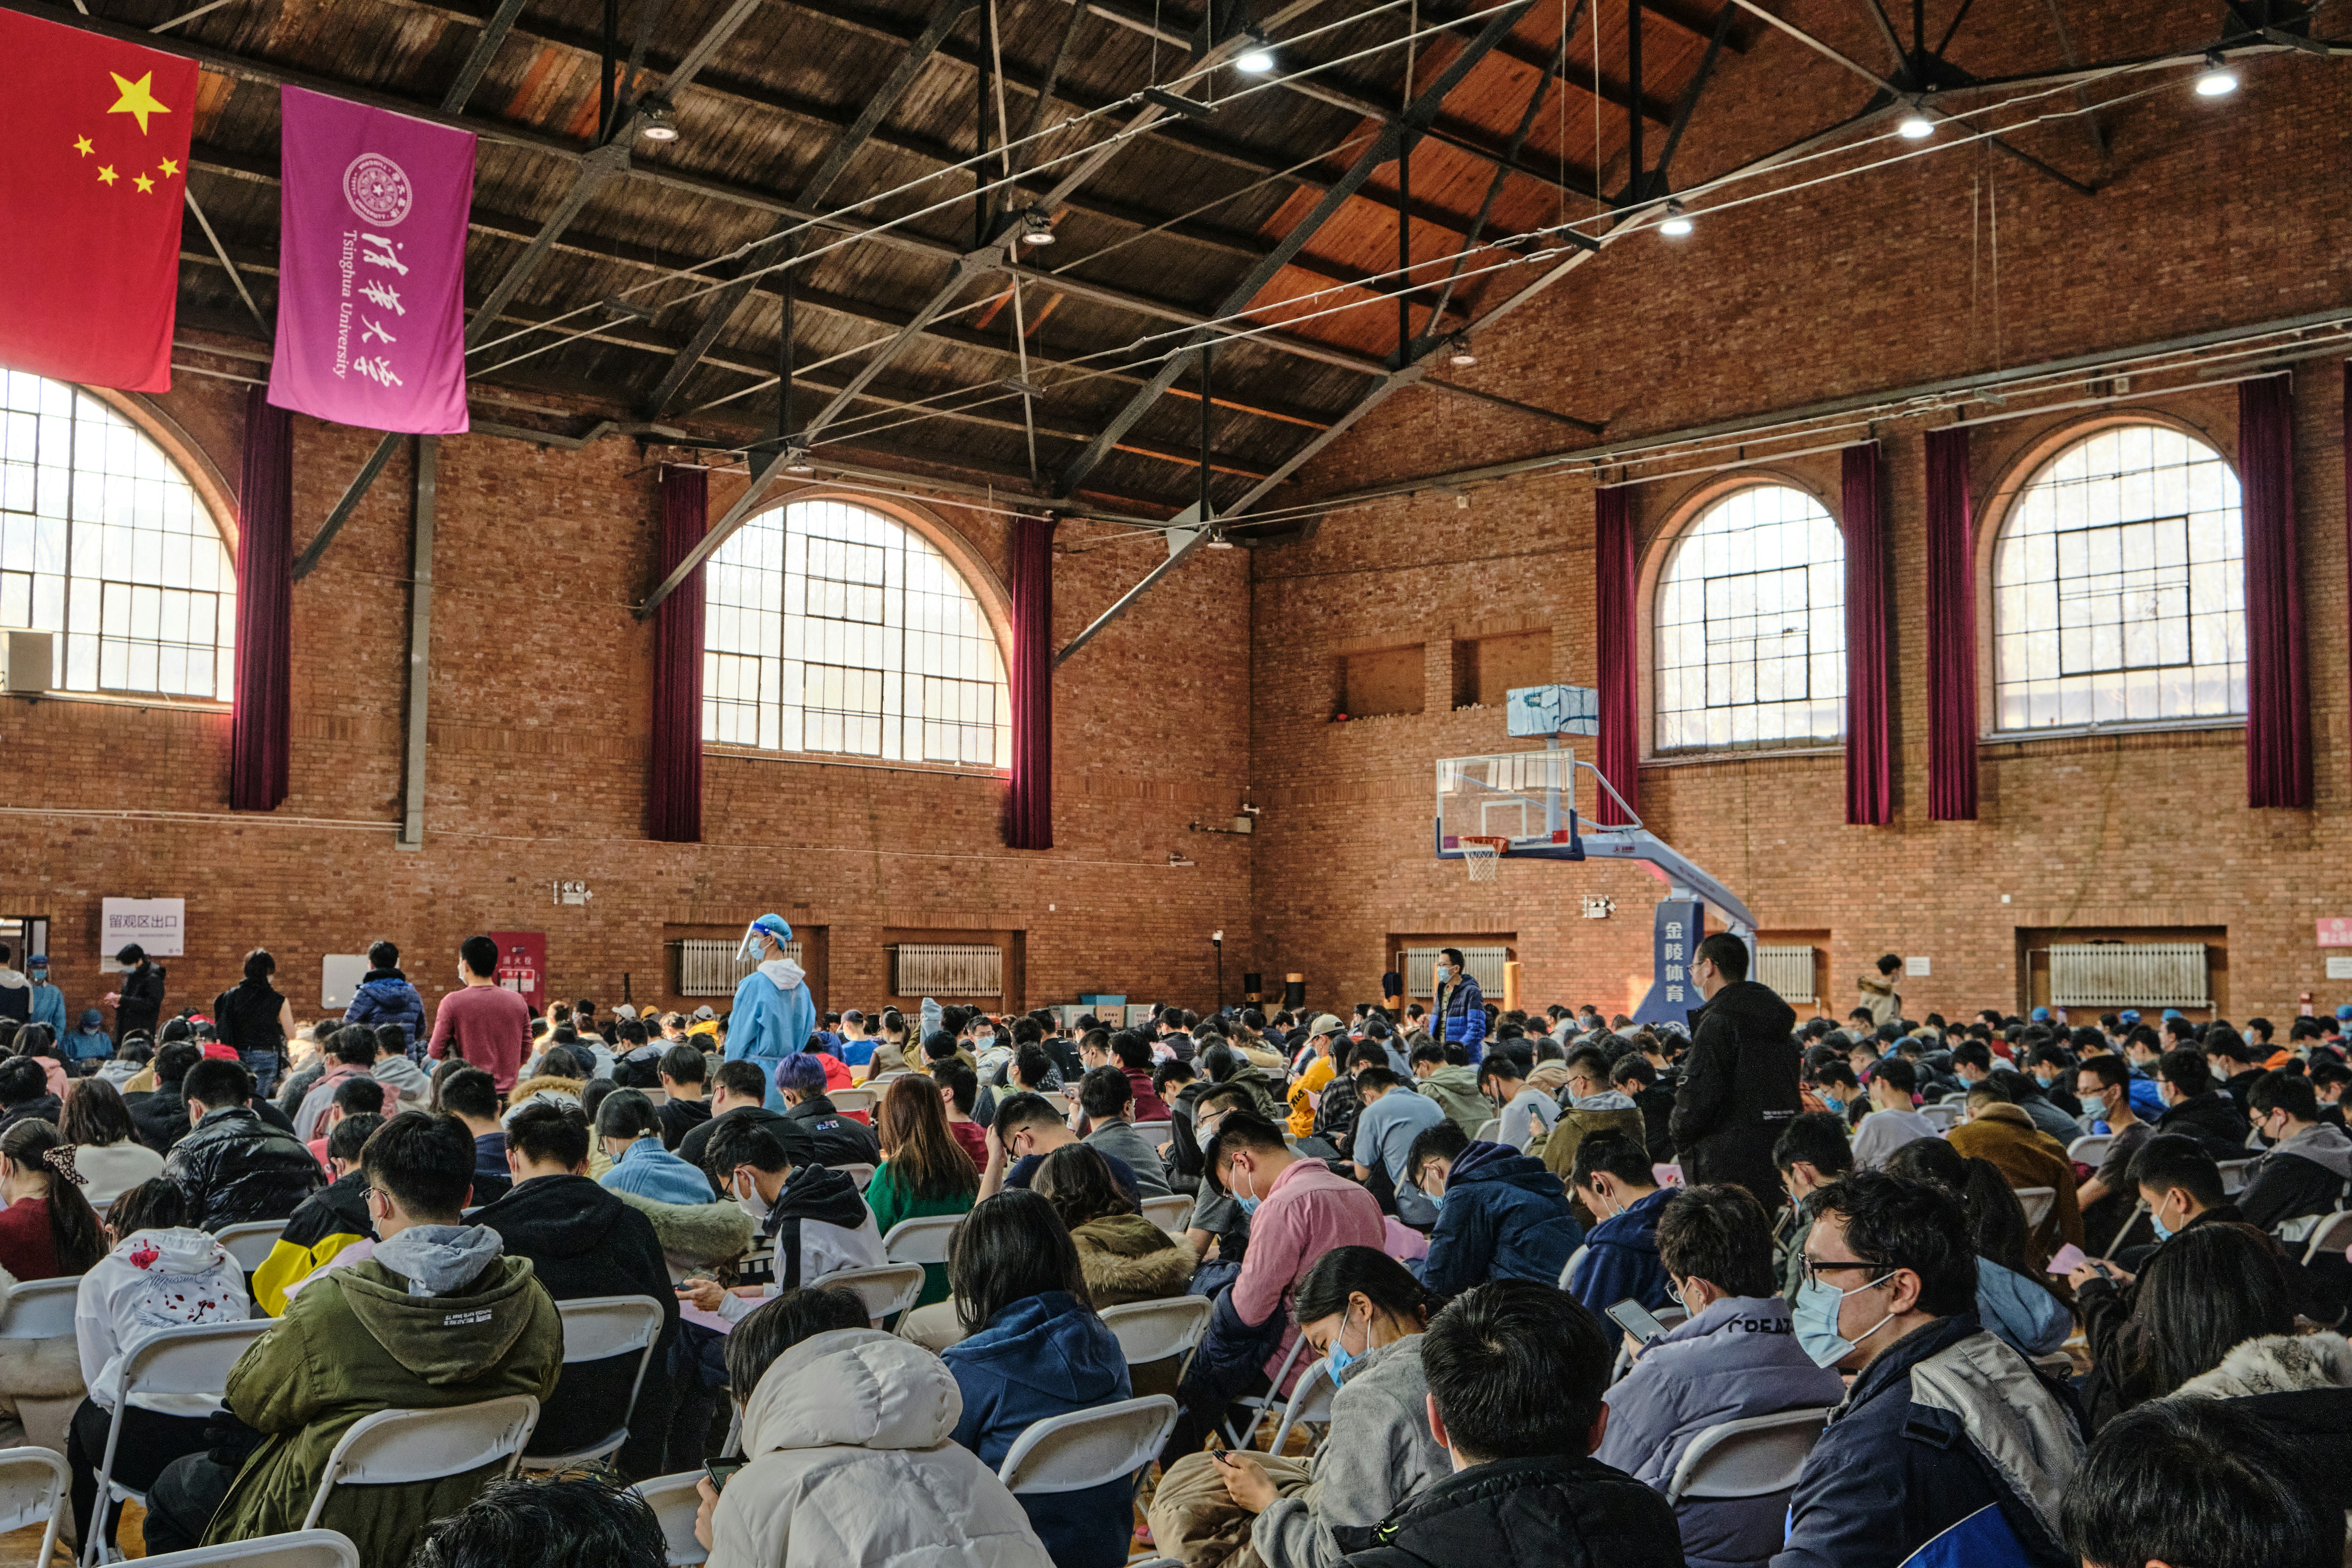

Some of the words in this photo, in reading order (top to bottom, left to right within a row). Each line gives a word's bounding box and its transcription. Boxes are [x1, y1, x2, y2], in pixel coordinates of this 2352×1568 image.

[339, 230, 357, 297] Tsinghua
[333, 302, 353, 379] University
[109, 914, 177, 928] 留观区出口
[1665, 922, 1684, 1002] 金陵体育
